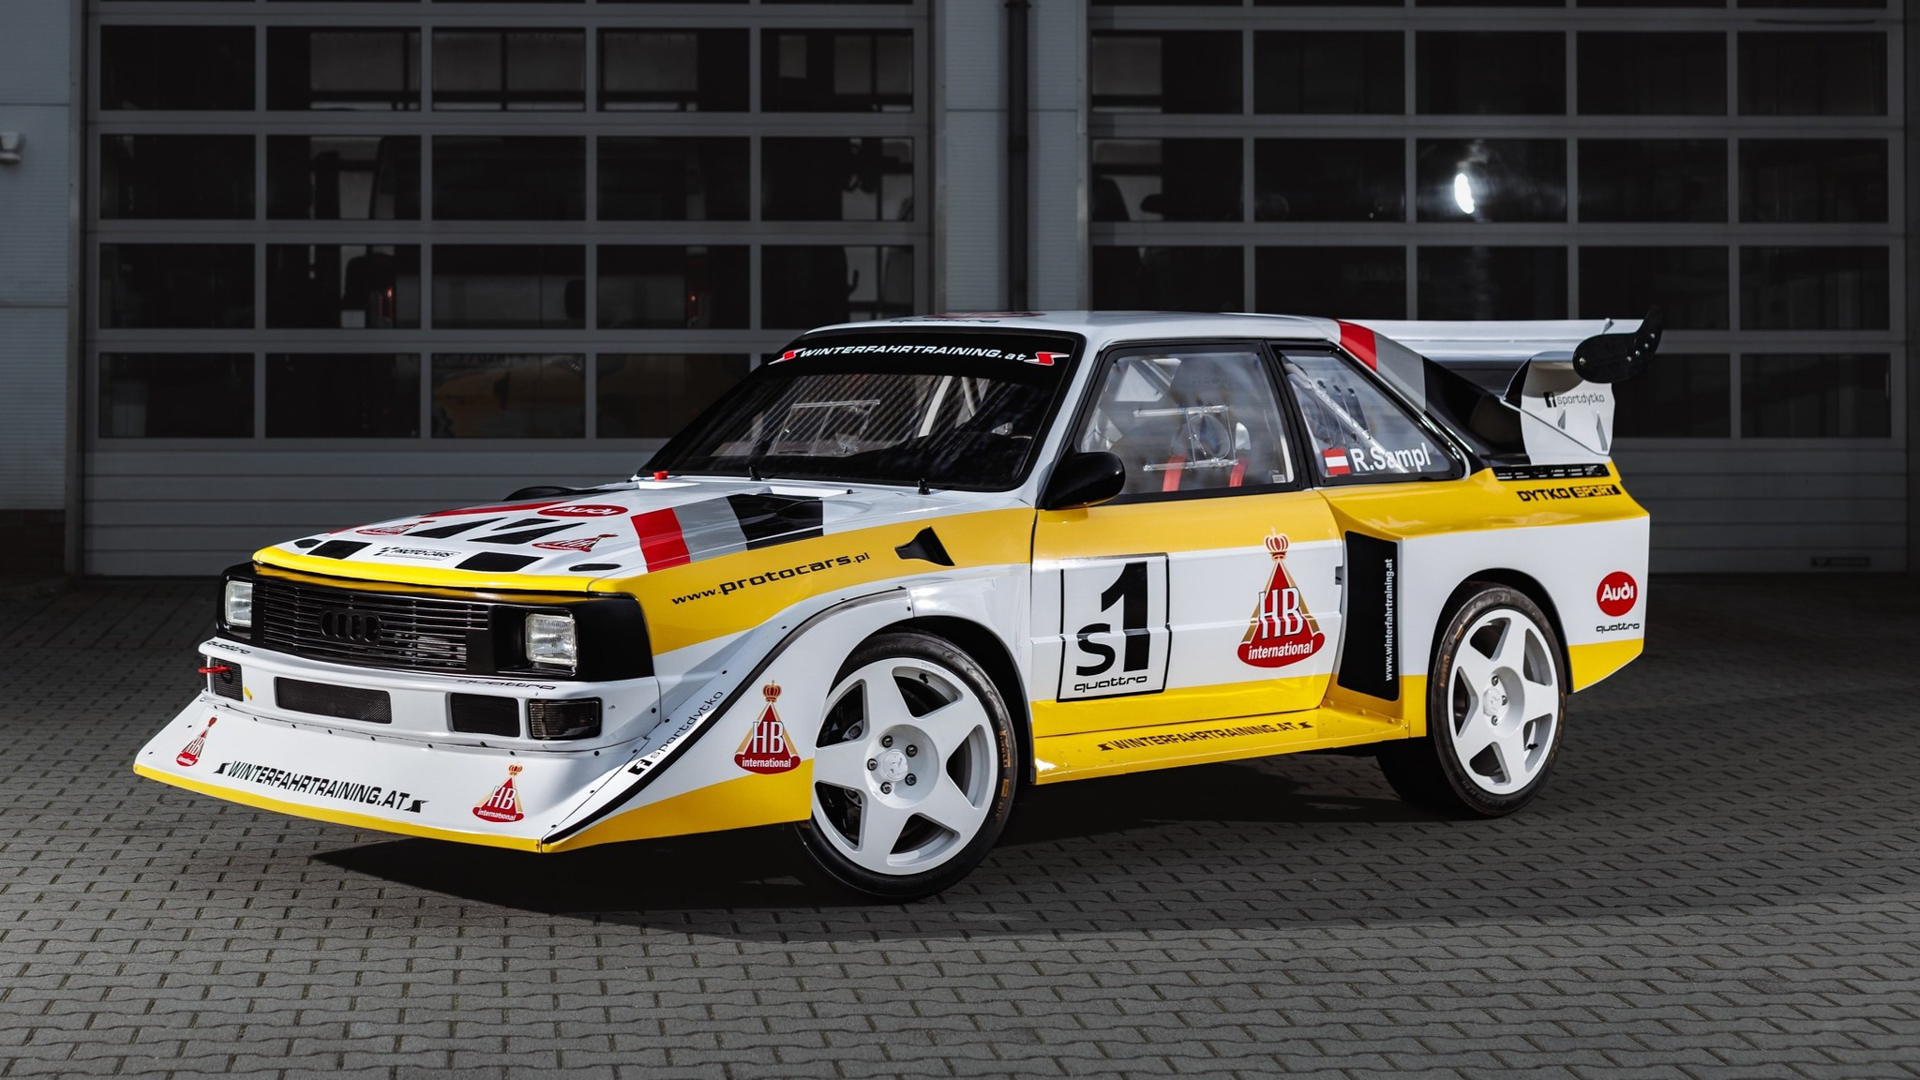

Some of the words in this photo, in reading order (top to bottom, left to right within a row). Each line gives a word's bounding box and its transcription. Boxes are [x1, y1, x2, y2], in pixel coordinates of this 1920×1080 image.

[800, 345, 1026, 361] WINTERFAHRTRAINING.at
[1557, 393, 1605, 405] sportdytko
[1349, 442, 1431, 472] R.Sampl
[1516, 488, 1571, 502] DYTKO
[1572, 484, 1617, 499] SPORT
[671, 552, 870, 605] www.protocars.pl
[1600, 581, 1634, 602] Audi
[1258, 587, 1304, 640] HB
[1384, 558, 1395, 682] www.winterfahrtraining.at
[1596, 622, 1640, 634] quattro
[1247, 640, 1314, 661] international
[1074, 675, 1148, 693] quattro
[650, 691, 724, 760] sportdytko
[751, 720, 785, 754] HB
[1108, 721, 1299, 750] WINTERFAHRTRAINING.AT
[741, 757, 792, 768] international
[227, 761, 410, 810] WINTERFAHRTRAINING.AT
[486, 785, 518, 810] HB
